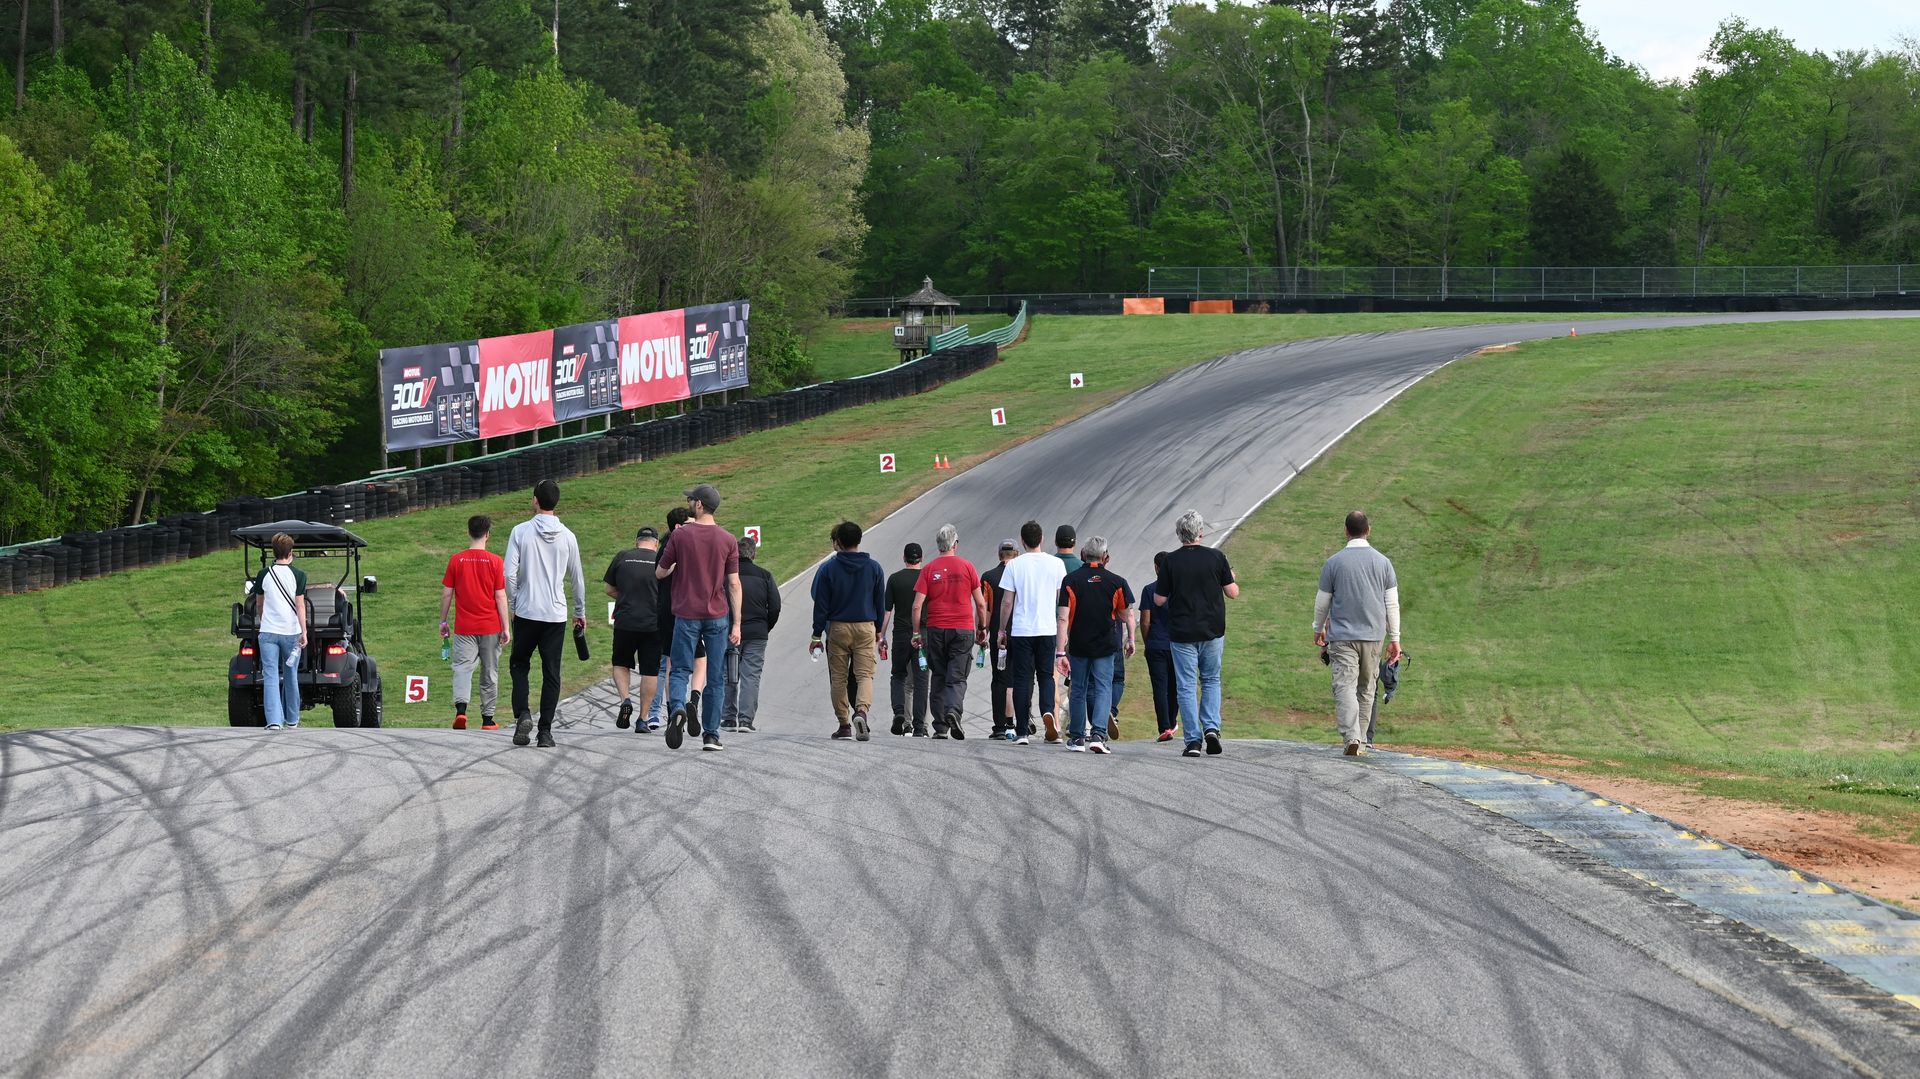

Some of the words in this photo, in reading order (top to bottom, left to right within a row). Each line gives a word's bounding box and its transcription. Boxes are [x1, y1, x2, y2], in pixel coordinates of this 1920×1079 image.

[689, 331, 719, 360] 300V
[555, 353, 588, 385] 300V
[621, 336, 684, 386] MOTUL
[391, 376, 437, 411] 300V
[482, 358, 549, 412] MOTUL
[393, 416, 408, 426] RACING
[408, 415, 423, 424] MOTOR
[423, 414, 432, 422] OILS
[994, 410, 1003, 423] 1
[882, 456, 893, 470] 2
[408, 679, 425, 701] 5
